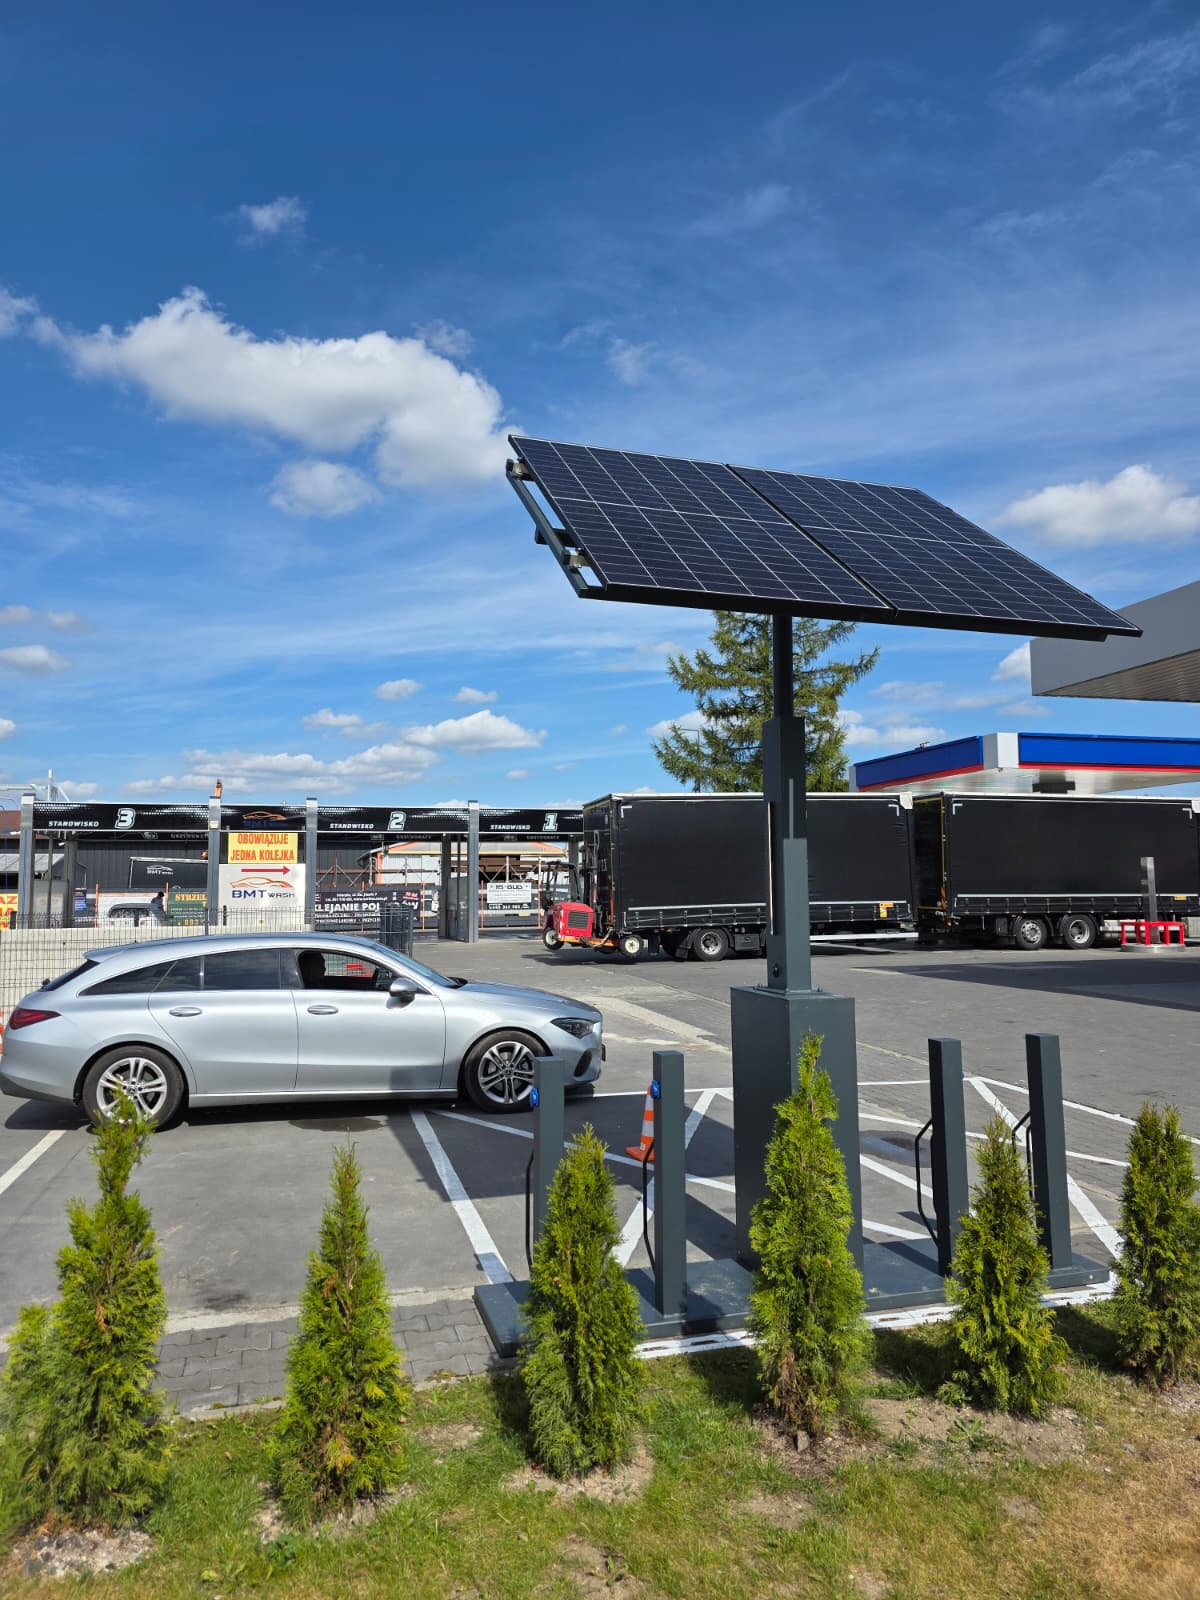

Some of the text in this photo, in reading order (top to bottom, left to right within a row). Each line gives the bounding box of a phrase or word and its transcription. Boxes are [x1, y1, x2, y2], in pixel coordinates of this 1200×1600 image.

[48, 808, 136, 829] STANOWISKO 3
[387, 811, 407, 831] 2
[543, 813, 558, 831] 1
[237, 833, 289, 846] OBOWIĄZUJE
[231, 849, 295, 861] JEDNA KOLEJKA
[231, 889, 267, 899] BMT
